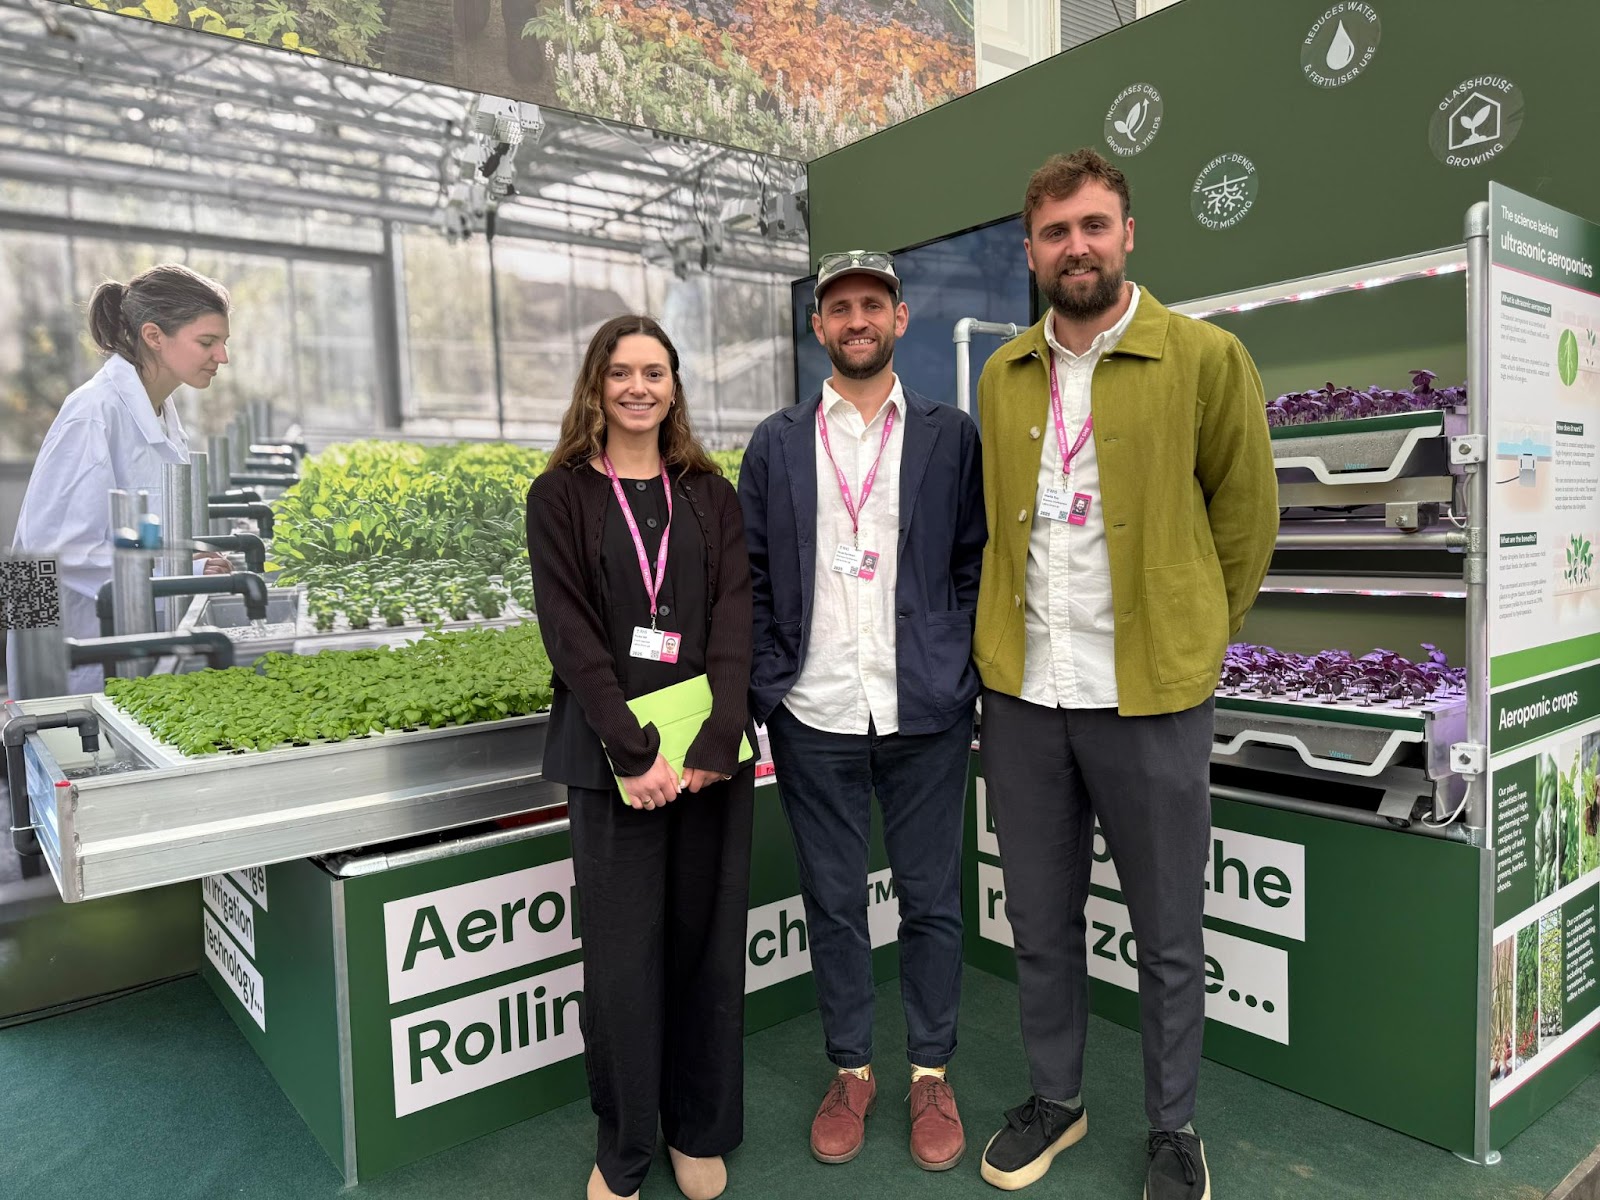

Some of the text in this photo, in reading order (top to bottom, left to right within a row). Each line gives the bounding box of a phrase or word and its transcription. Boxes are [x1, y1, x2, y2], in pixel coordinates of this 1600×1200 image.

[1305, 1, 1378, 45] REDUCES WATER
[1304, 45, 1376, 87] & FERTILISER USE
[1106, 84, 1161, 121] INCREASES CROP
[1438, 76, 1513, 111] GLASSHOUSE
[1106, 135, 1134, 156] GROWTH
[1141, 116, 1161, 146] YIELDS
[1446, 142, 1504, 167] GROWING
[1193, 154, 1255, 193] NUTRIENT-DENSE
[1197, 199, 1253, 230] ROOT MISTING
[1501, 205, 1558, 239] The science behind
[1501, 232, 1593, 278] ultrasonic aeroponics
[1499, 690, 1578, 730] Aeroponic crops
[1329, 750, 1353, 759] Water
[1498, 783, 1517, 796] Our plant
[241, 866, 264, 896] nge
[211, 877, 253, 942] irrigation
[206, 919, 263, 1014] technology...
[408, 985, 583, 1085] Rollin
